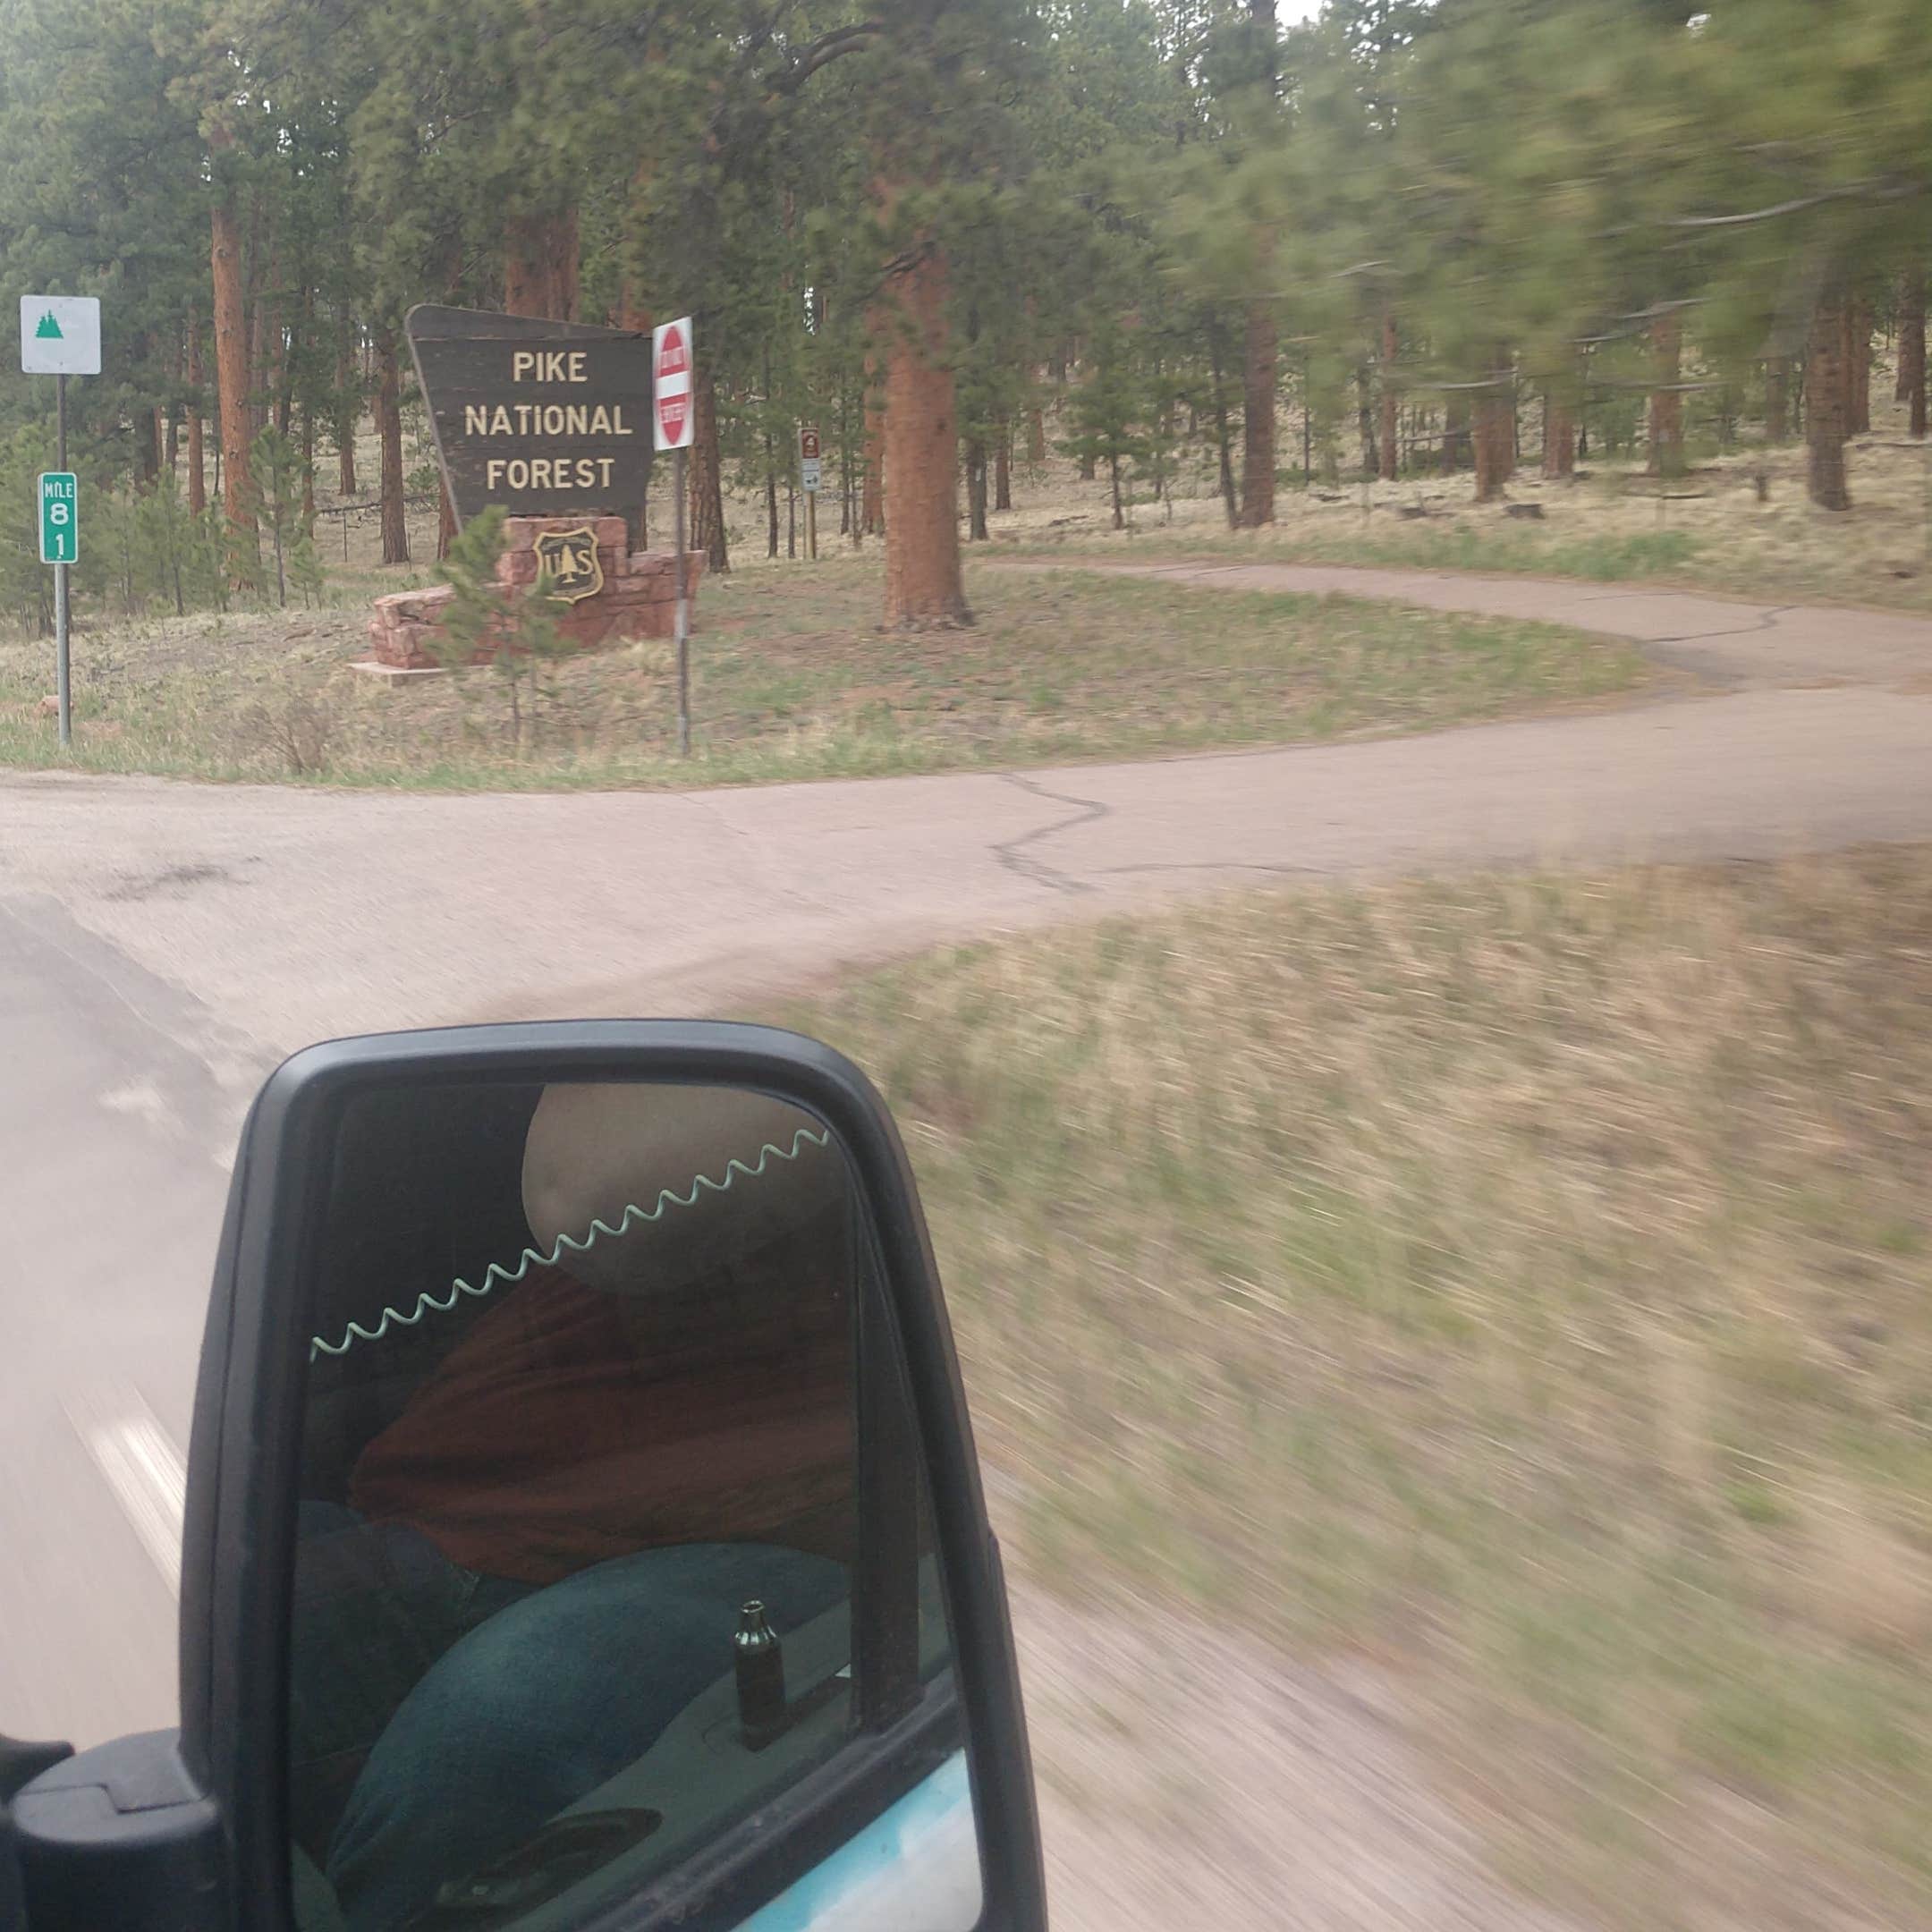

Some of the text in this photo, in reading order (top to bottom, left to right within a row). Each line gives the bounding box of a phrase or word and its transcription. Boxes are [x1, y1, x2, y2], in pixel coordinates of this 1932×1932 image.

[513, 352, 588, 382] PIKE
[464, 405, 633, 436] NATIONAL
[487, 458, 615, 490] FOREST
[45, 481, 73, 498] MILE
